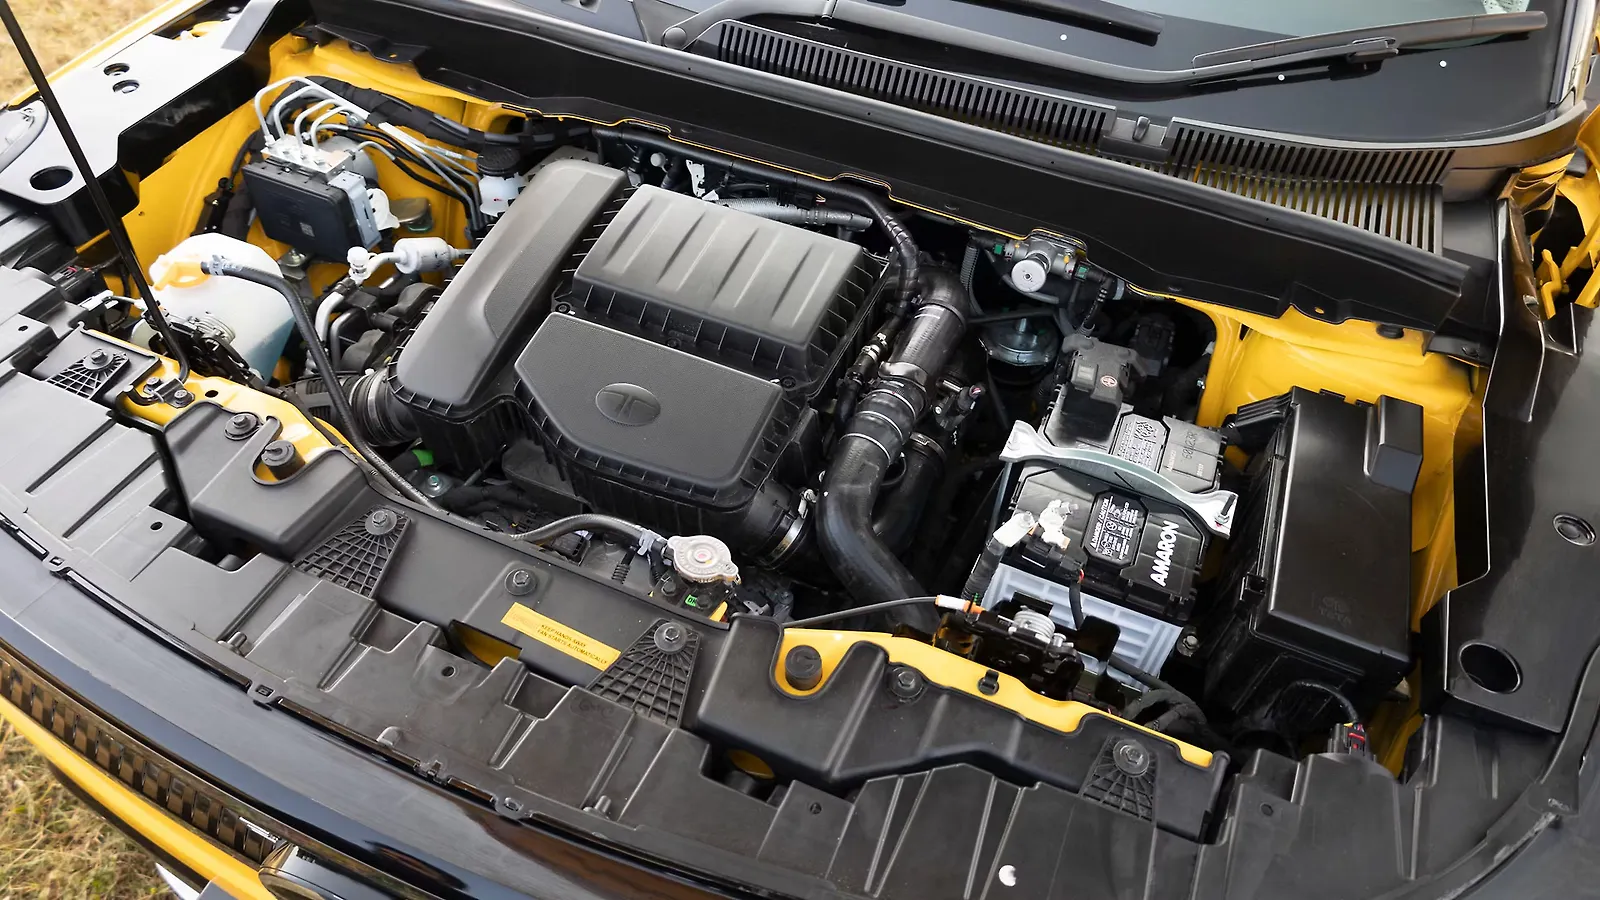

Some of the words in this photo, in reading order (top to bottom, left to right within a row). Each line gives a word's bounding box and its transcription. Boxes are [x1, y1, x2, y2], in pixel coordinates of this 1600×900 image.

[1150, 520, 1179, 587] AMARON
[537, 629, 547, 637] FAN
[549, 635, 567, 646] STARTS
[567, 643, 608, 664] AUTOMATICALLY
[541, 624, 553, 632] KEEP
[555, 630, 572, 642] HANDS
[573, 638, 587, 648] AWAY
